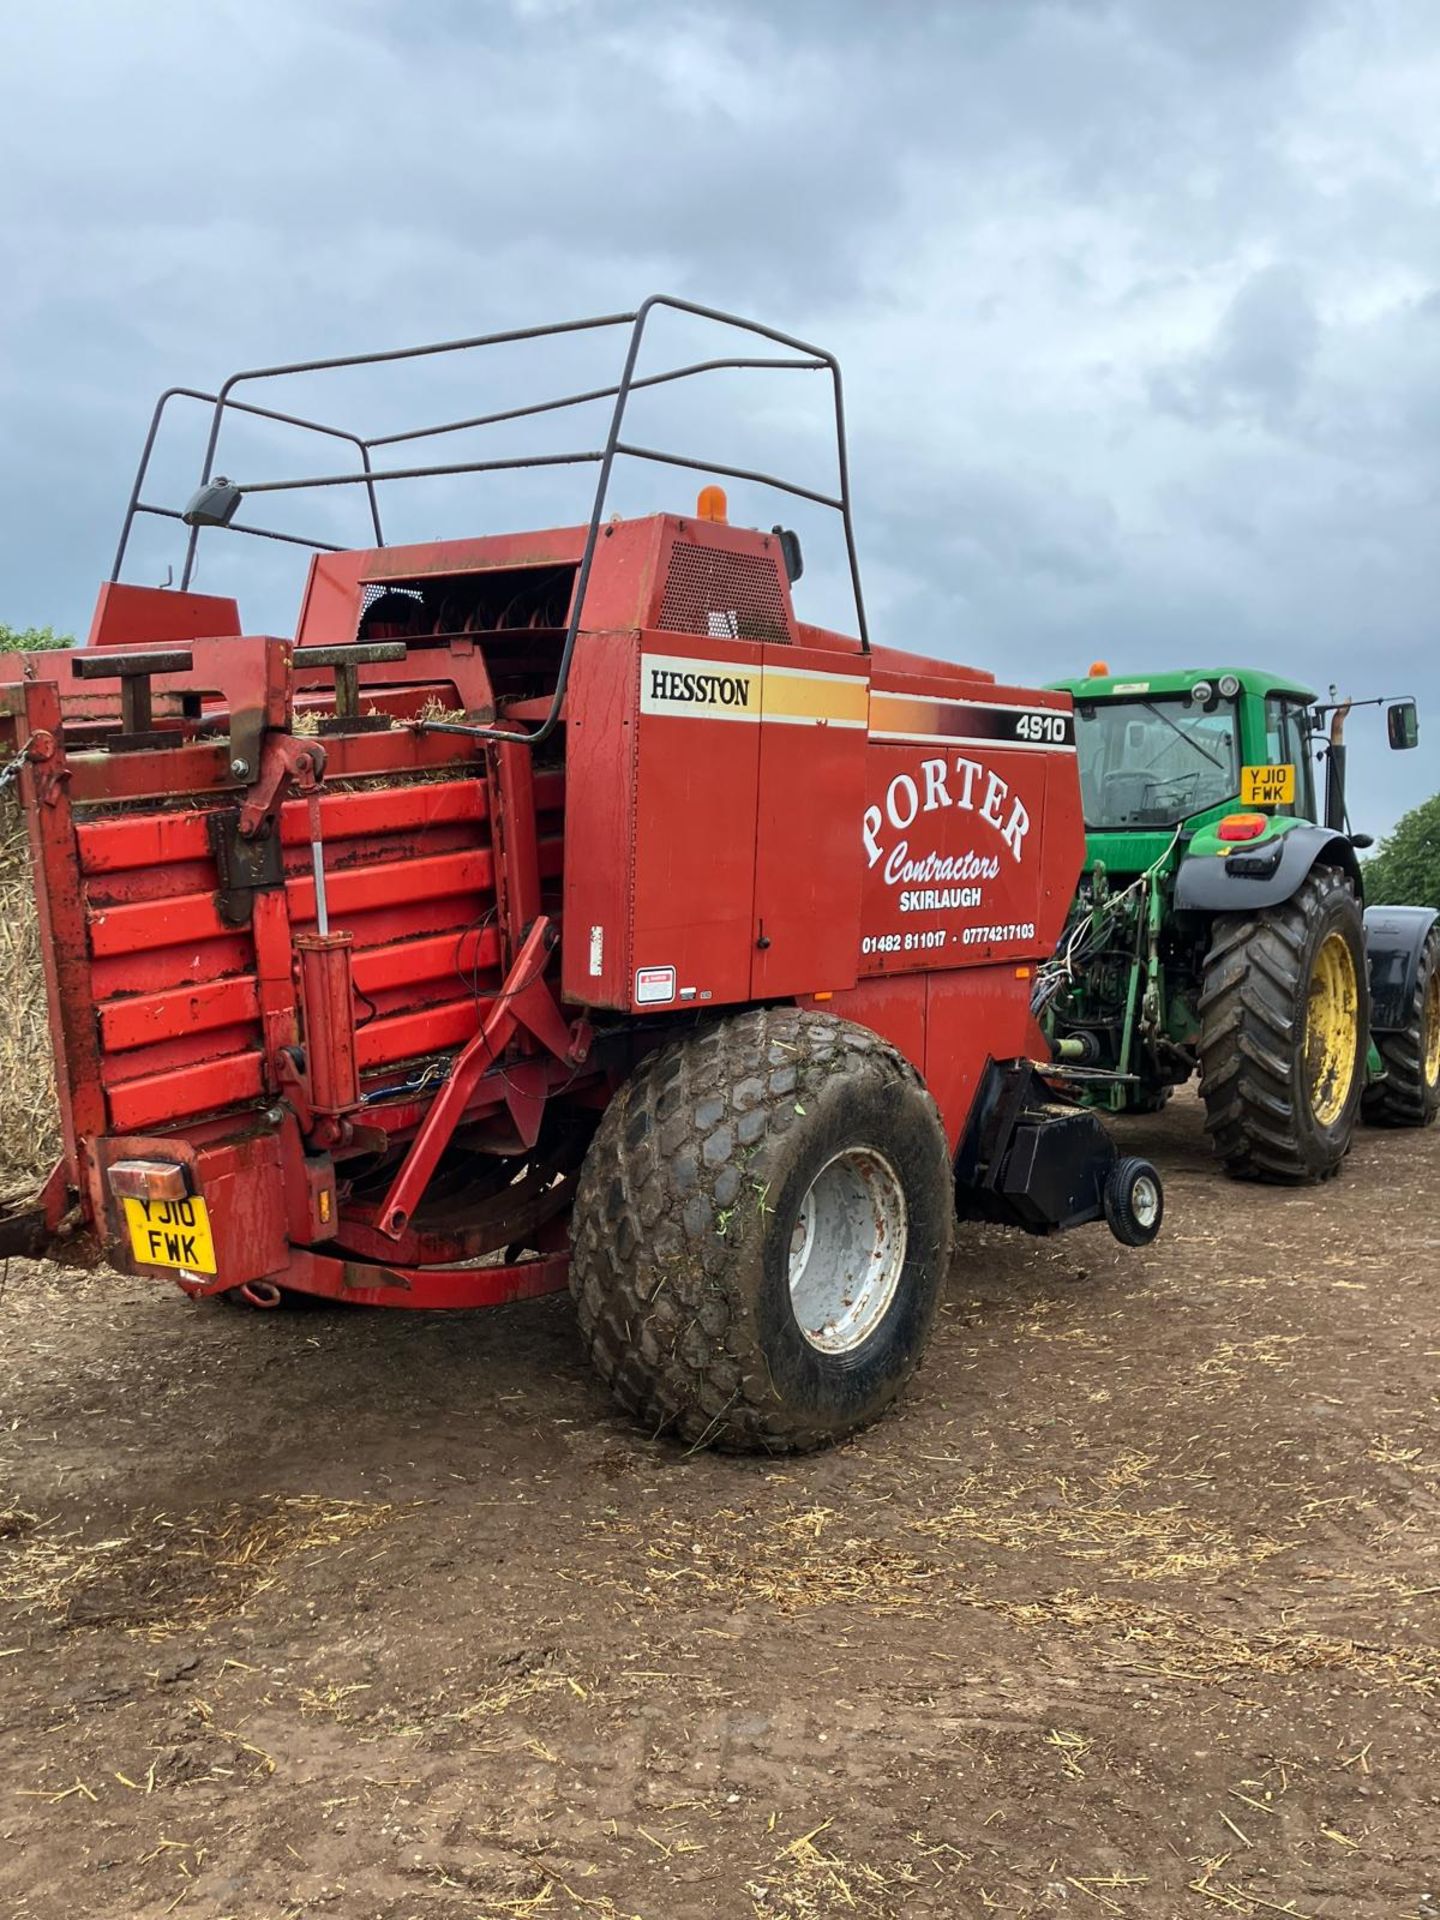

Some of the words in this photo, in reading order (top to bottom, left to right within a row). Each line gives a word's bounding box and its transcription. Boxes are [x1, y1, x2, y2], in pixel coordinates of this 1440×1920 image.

[651, 669, 750, 706] HESSTON
[1016, 714, 1066, 742] 4910
[1250, 768, 1286, 784] YJ10
[1252, 786, 1284, 801] FWK
[862, 756, 1030, 869] PORTER
[884, 840, 1000, 885] Contractors
[900, 887, 981, 913] SKIRLAUGH
[862, 936, 901, 954] 01482
[904, 930, 946, 950] 811017
[962, 923, 1034, 944] 07774217103
[140, 1199, 196, 1227] YJ10
[147, 1229, 199, 1265] FWK
